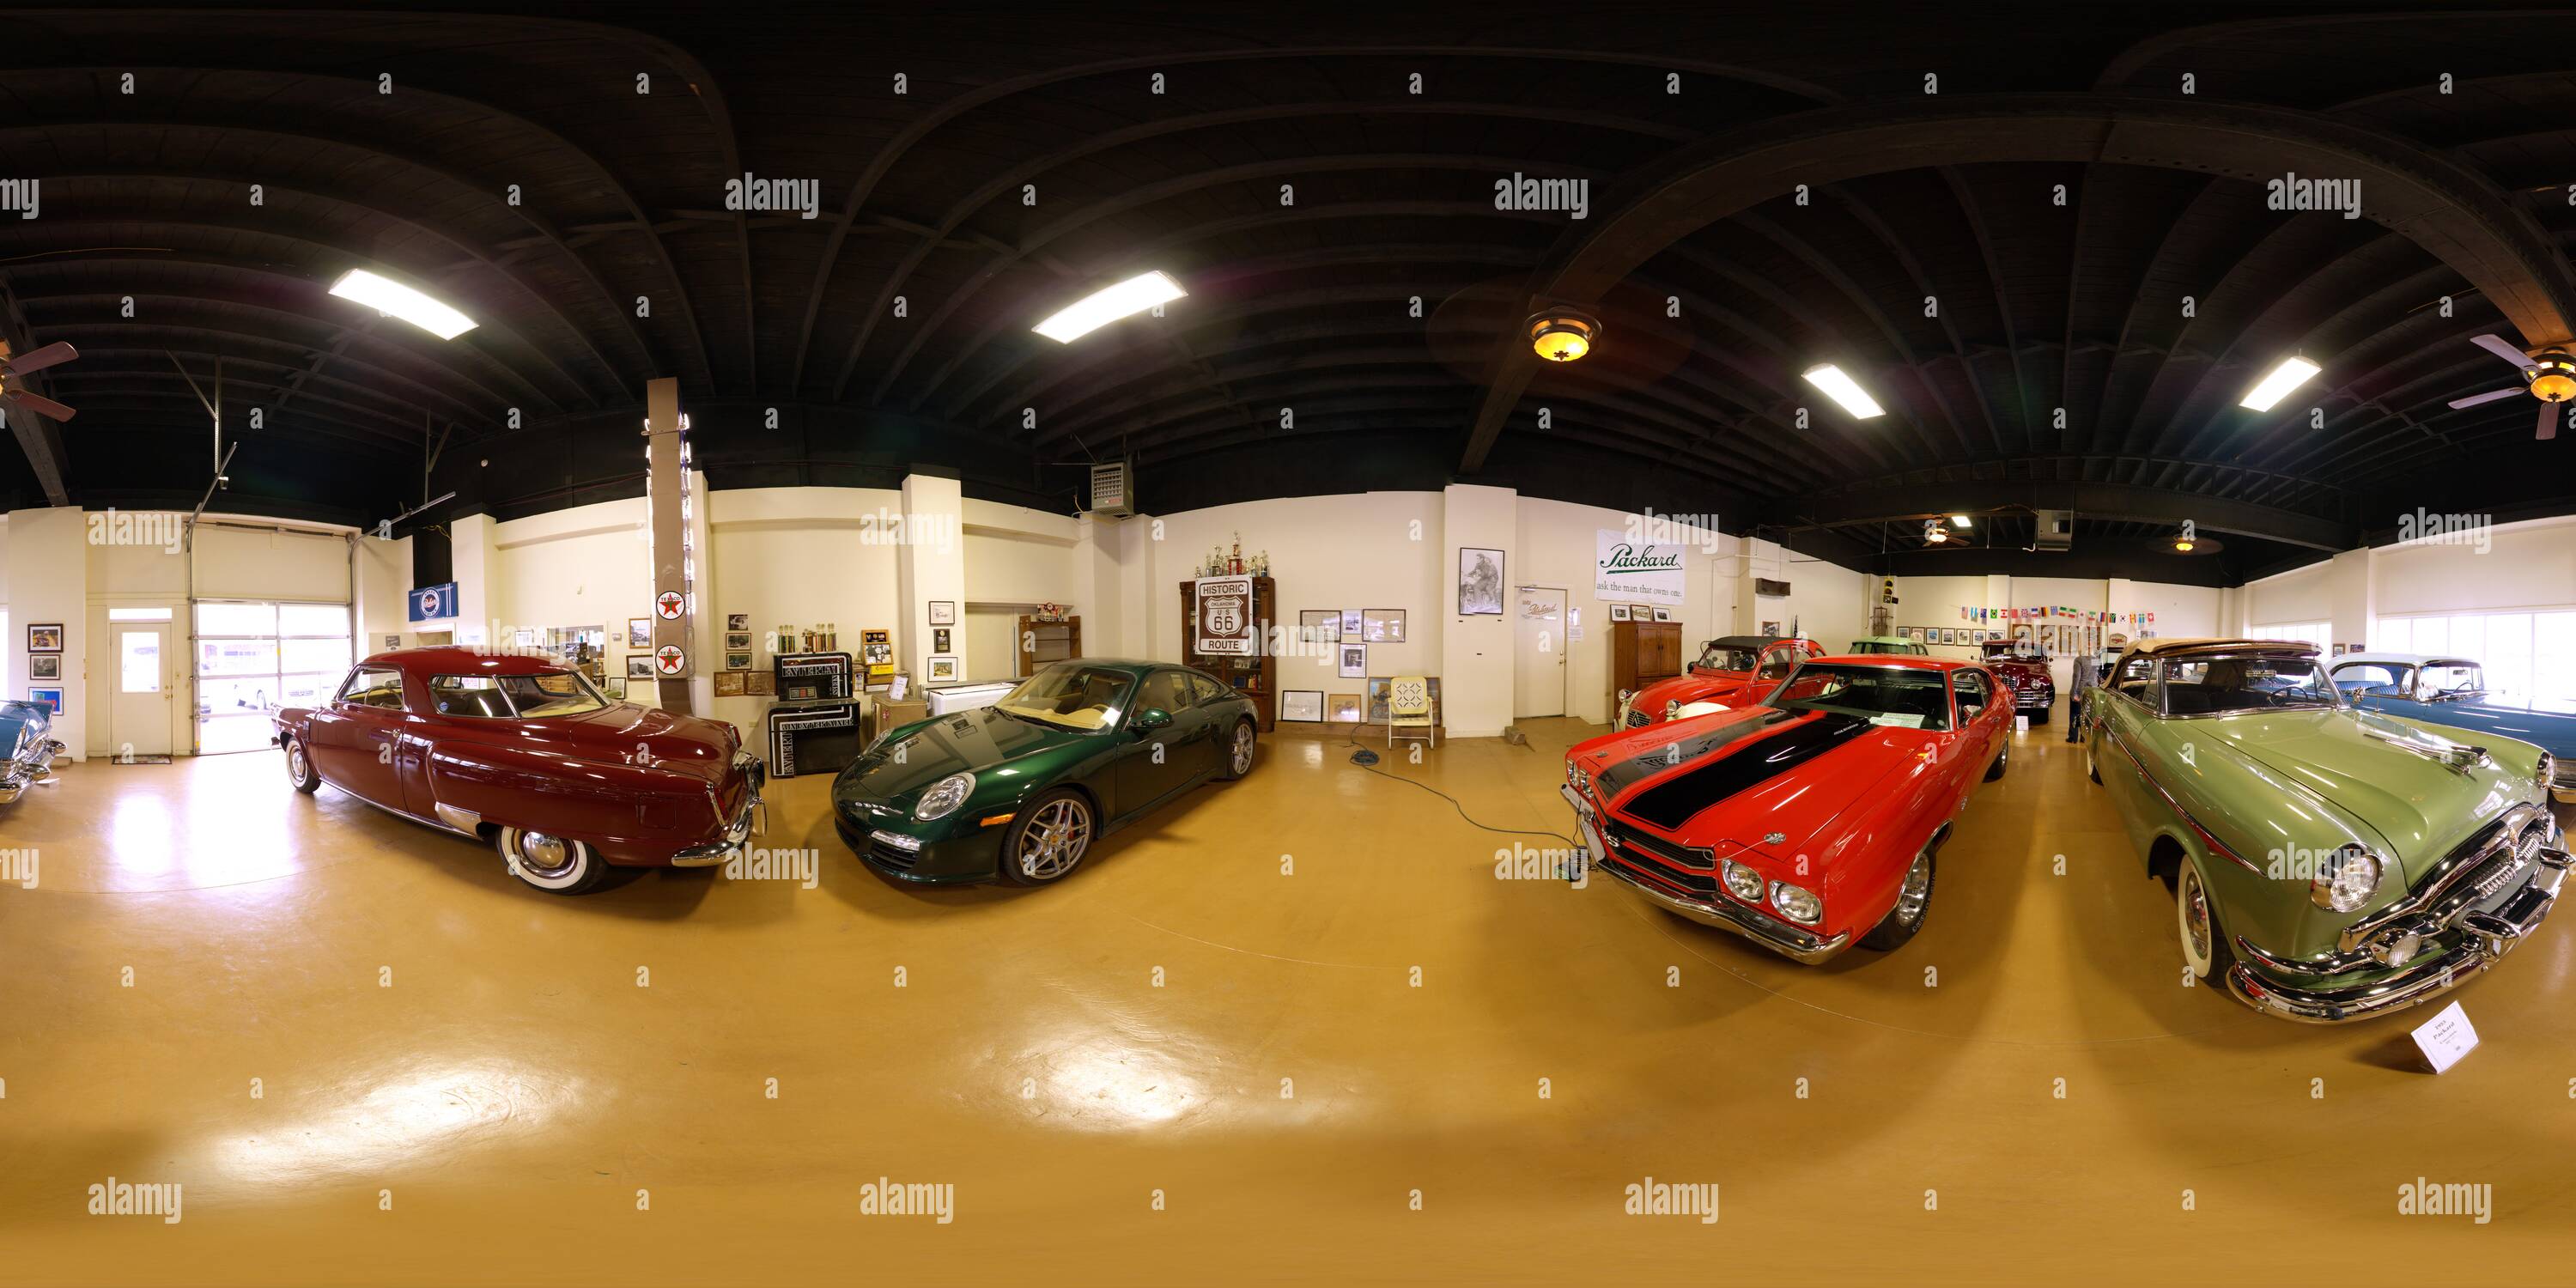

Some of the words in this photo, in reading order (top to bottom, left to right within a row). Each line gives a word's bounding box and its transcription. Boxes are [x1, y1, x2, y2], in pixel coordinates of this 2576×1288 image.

[1600, 543, 1683, 569] Packard
[1203, 584, 1244, 594] HISTORIC
[1596, 580, 1609, 591] ask
[1610, 581, 1622, 592] the
[1639, 584, 1652, 593] that
[1214, 616, 1233, 630] 66
[1208, 640, 1239, 649] ROUTE
